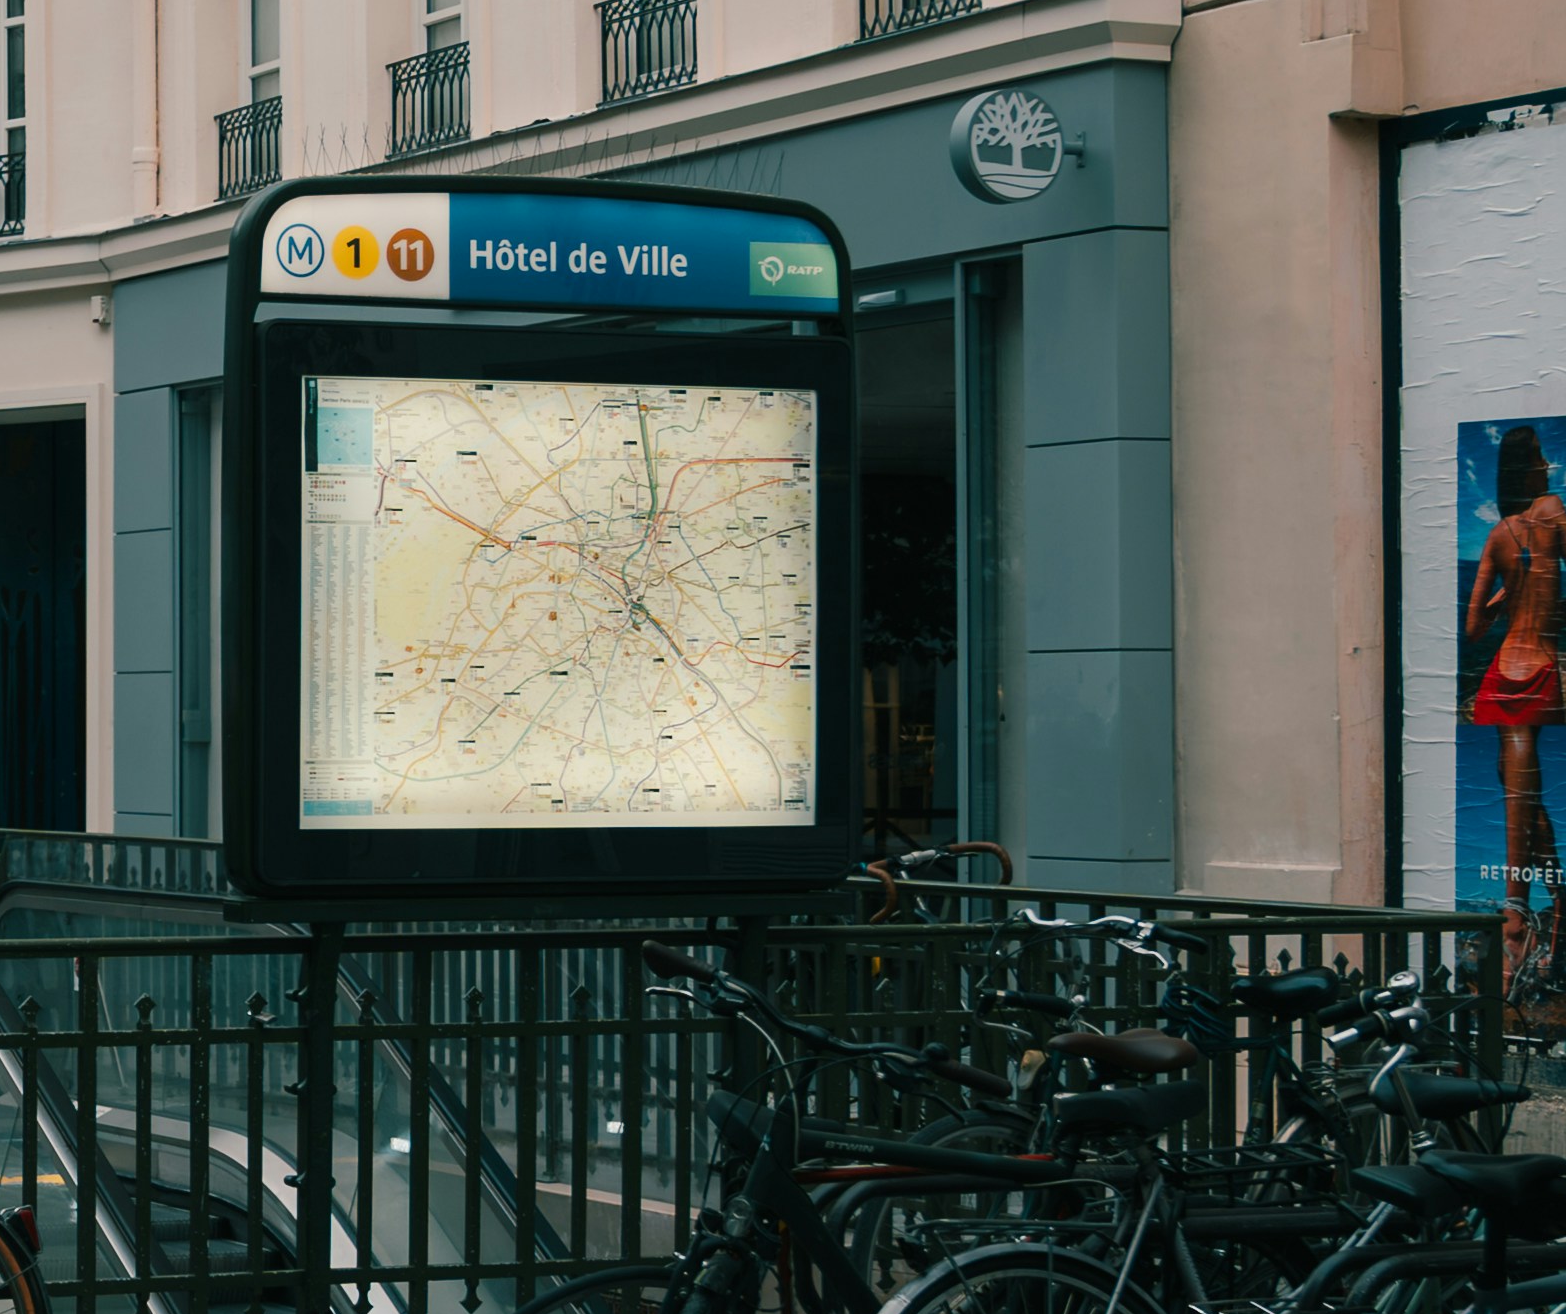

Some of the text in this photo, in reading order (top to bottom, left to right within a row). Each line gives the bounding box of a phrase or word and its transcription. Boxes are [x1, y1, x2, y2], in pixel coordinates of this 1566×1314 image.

[346, 238, 362, 268] 1
[394, 238, 426, 272] 11
[469, 238, 689, 279] Hôtel de Ville
[787, 263, 824, 276] RATP
